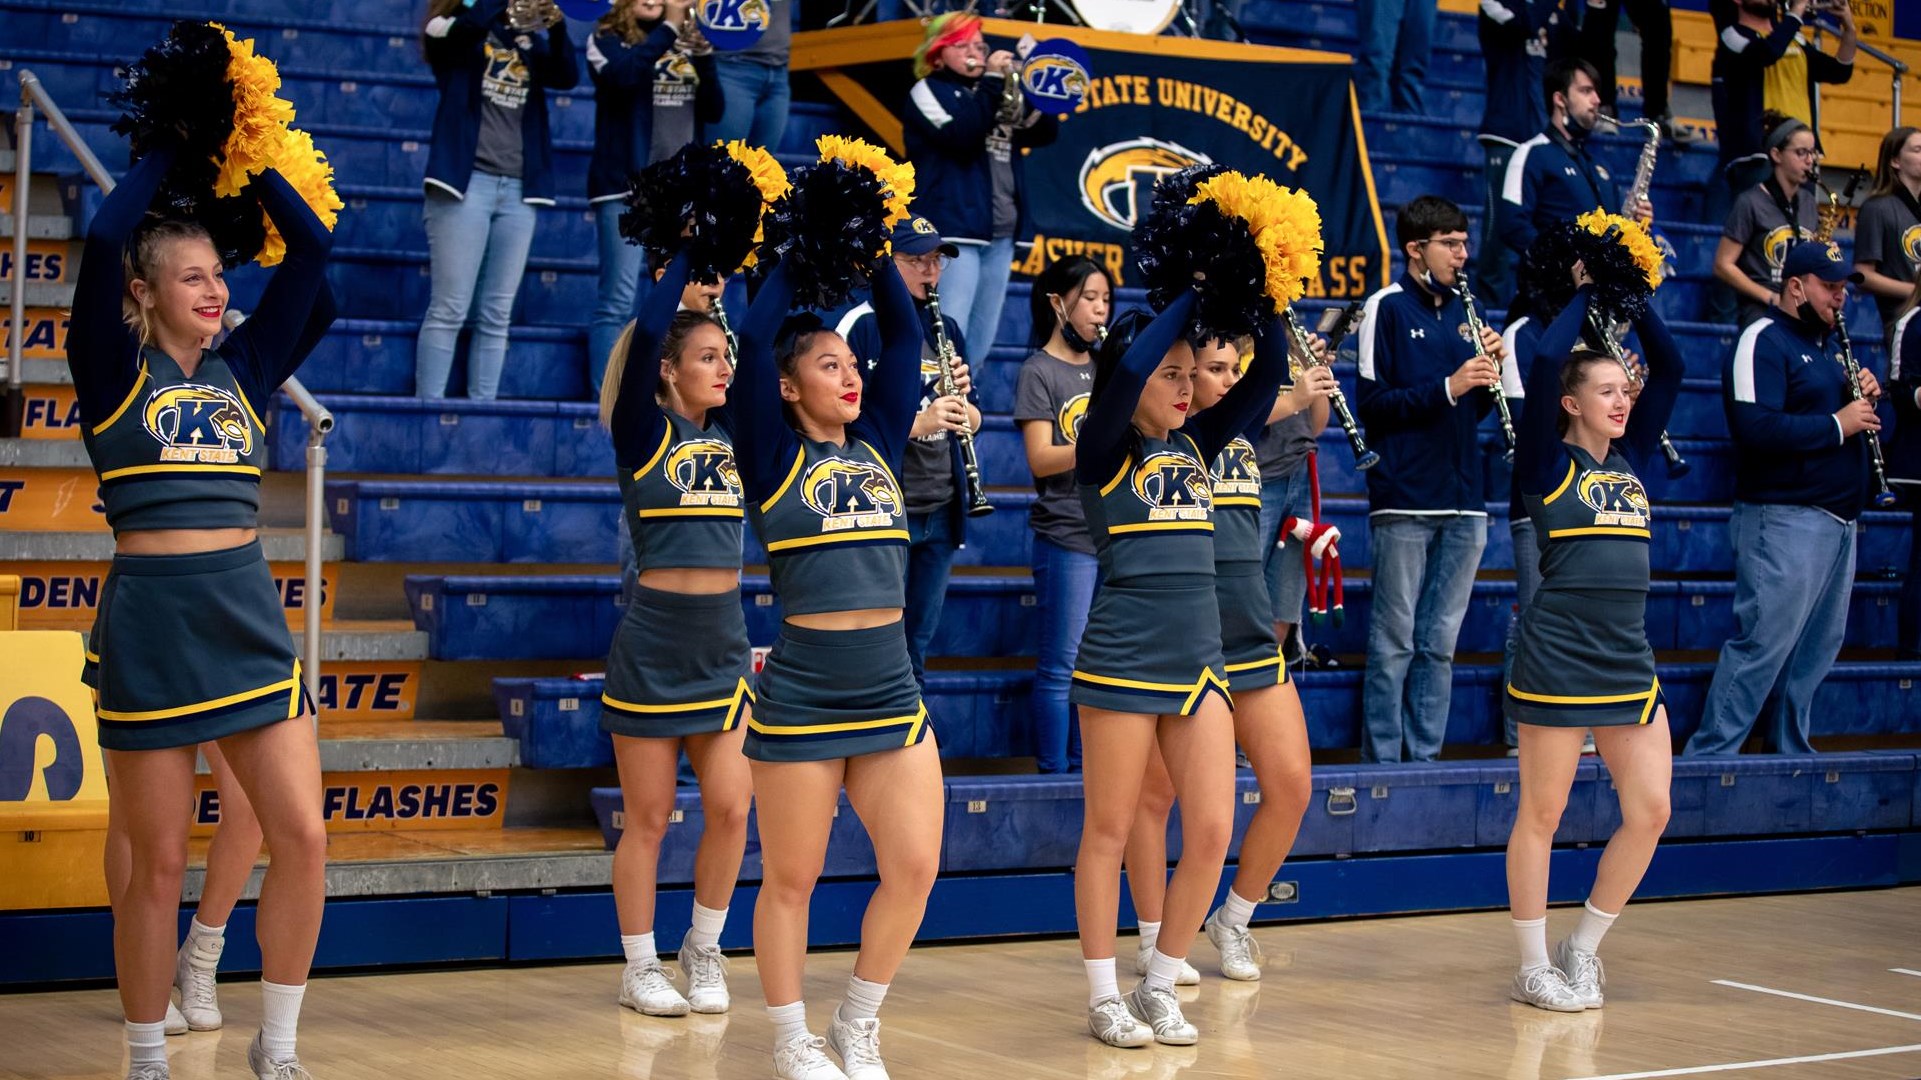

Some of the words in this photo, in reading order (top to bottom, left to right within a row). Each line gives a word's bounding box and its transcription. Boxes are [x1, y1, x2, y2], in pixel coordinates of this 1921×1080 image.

[1034, 64, 1077, 99] K
[1157, 77, 1310, 172] UNIVERSITY
[1010, 234, 1124, 286] ASR
[170, 398, 229, 448] K
[160, 447, 199, 461] KENT
[198, 449, 238, 463] STATE
[687, 451, 730, 494] K
[1220, 446, 1251, 482] K
[680, 493, 709, 506] KENT
[710, 494, 739, 506] STATE
[829, 469, 879, 517] K
[1156, 464, 1198, 508] K
[1213, 482, 1237, 494] KENT
[1597, 480, 1638, 516] K
[822, 515, 857, 532] KENT
[857, 512, 893, 528] STATE
[1148, 508, 1178, 520] KENT
[1178, 508, 1208, 520] STATE
[1594, 513, 1620, 525] KENT
[1620, 514, 1646, 527] STATE
[19, 576, 100, 608] DEN
[320, 673, 409, 710] ATE
[323, 783, 499, 820] FLASHES
